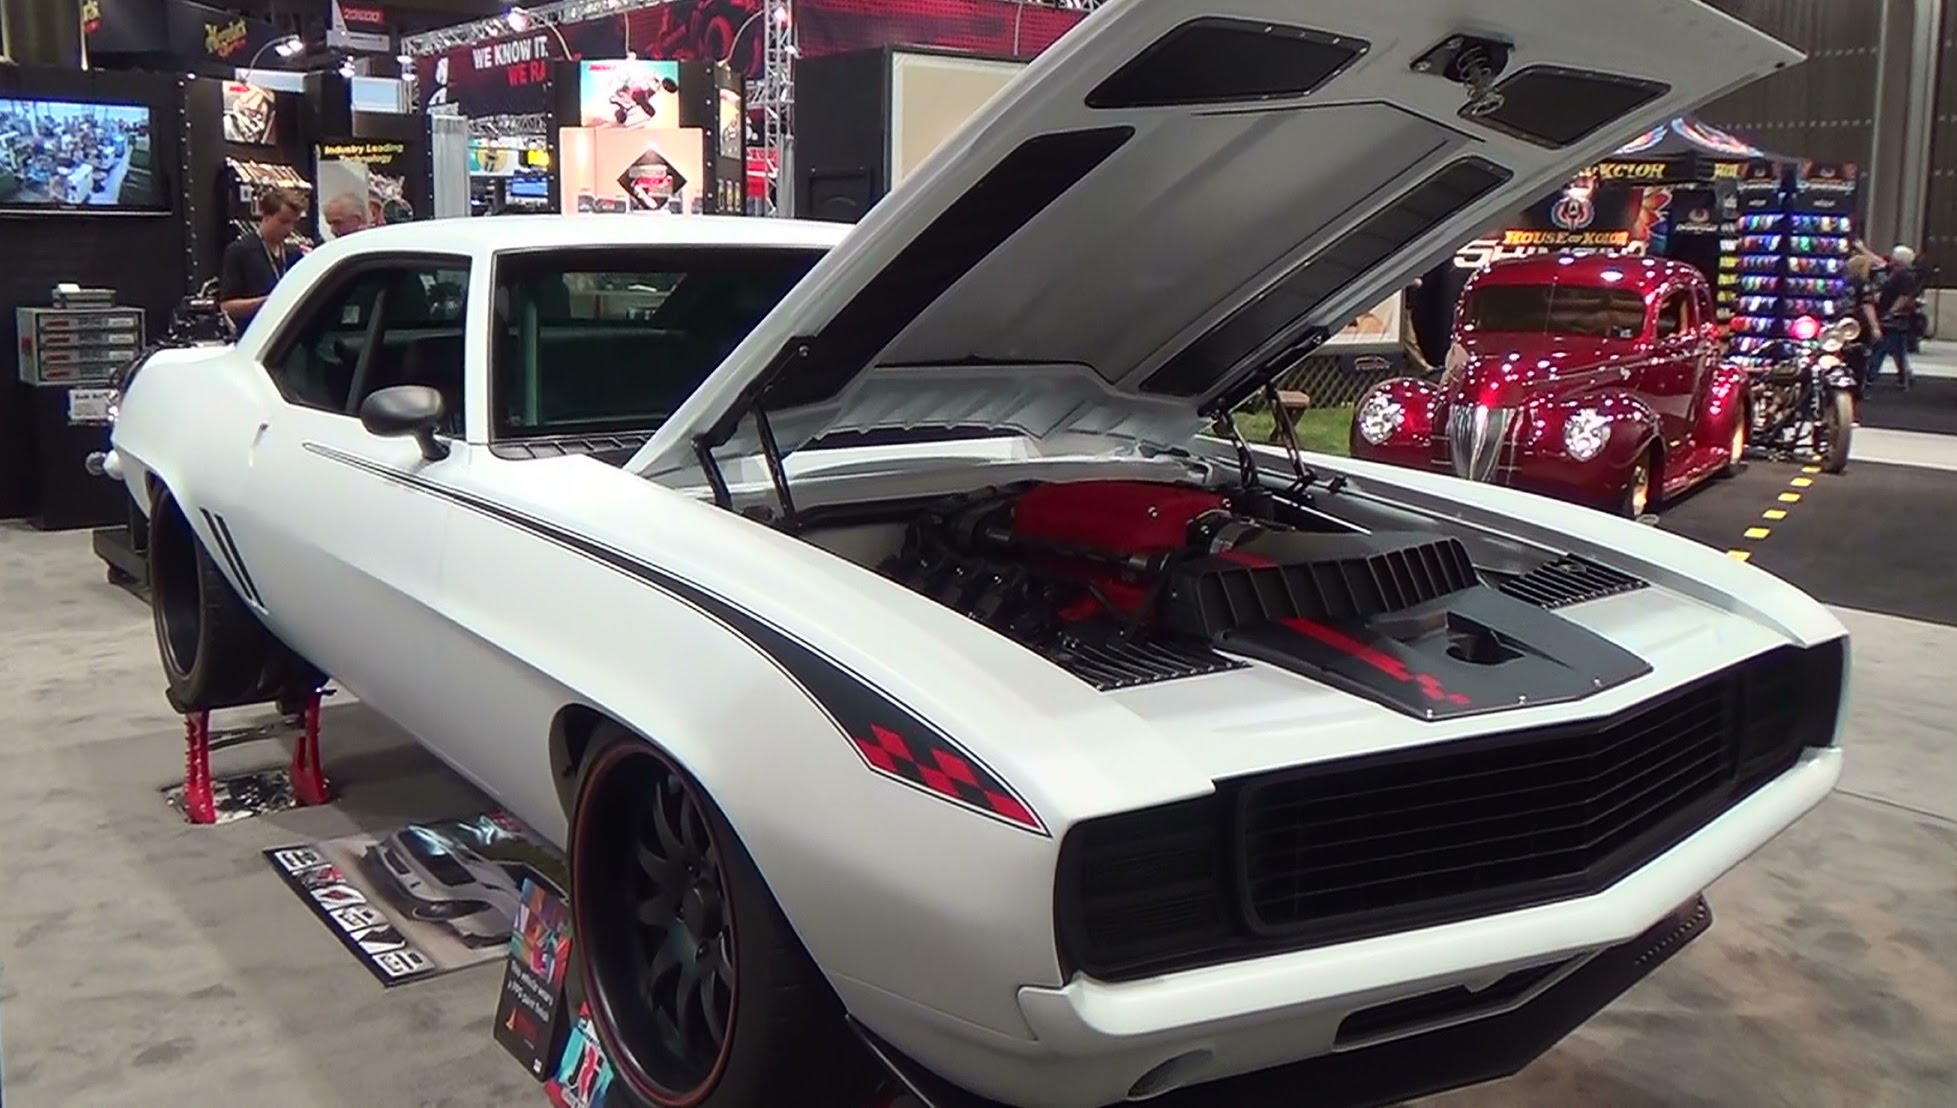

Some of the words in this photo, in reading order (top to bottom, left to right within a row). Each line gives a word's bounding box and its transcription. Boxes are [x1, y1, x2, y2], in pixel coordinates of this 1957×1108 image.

[472, 46, 492, 69] WE
[494, 39, 531, 66] KNOW
[508, 64, 528, 86] WE
[324, 145, 364, 155] Industry
[1503, 230, 1567, 245] HOUSE
[1582, 230, 1629, 246] KOLOR
